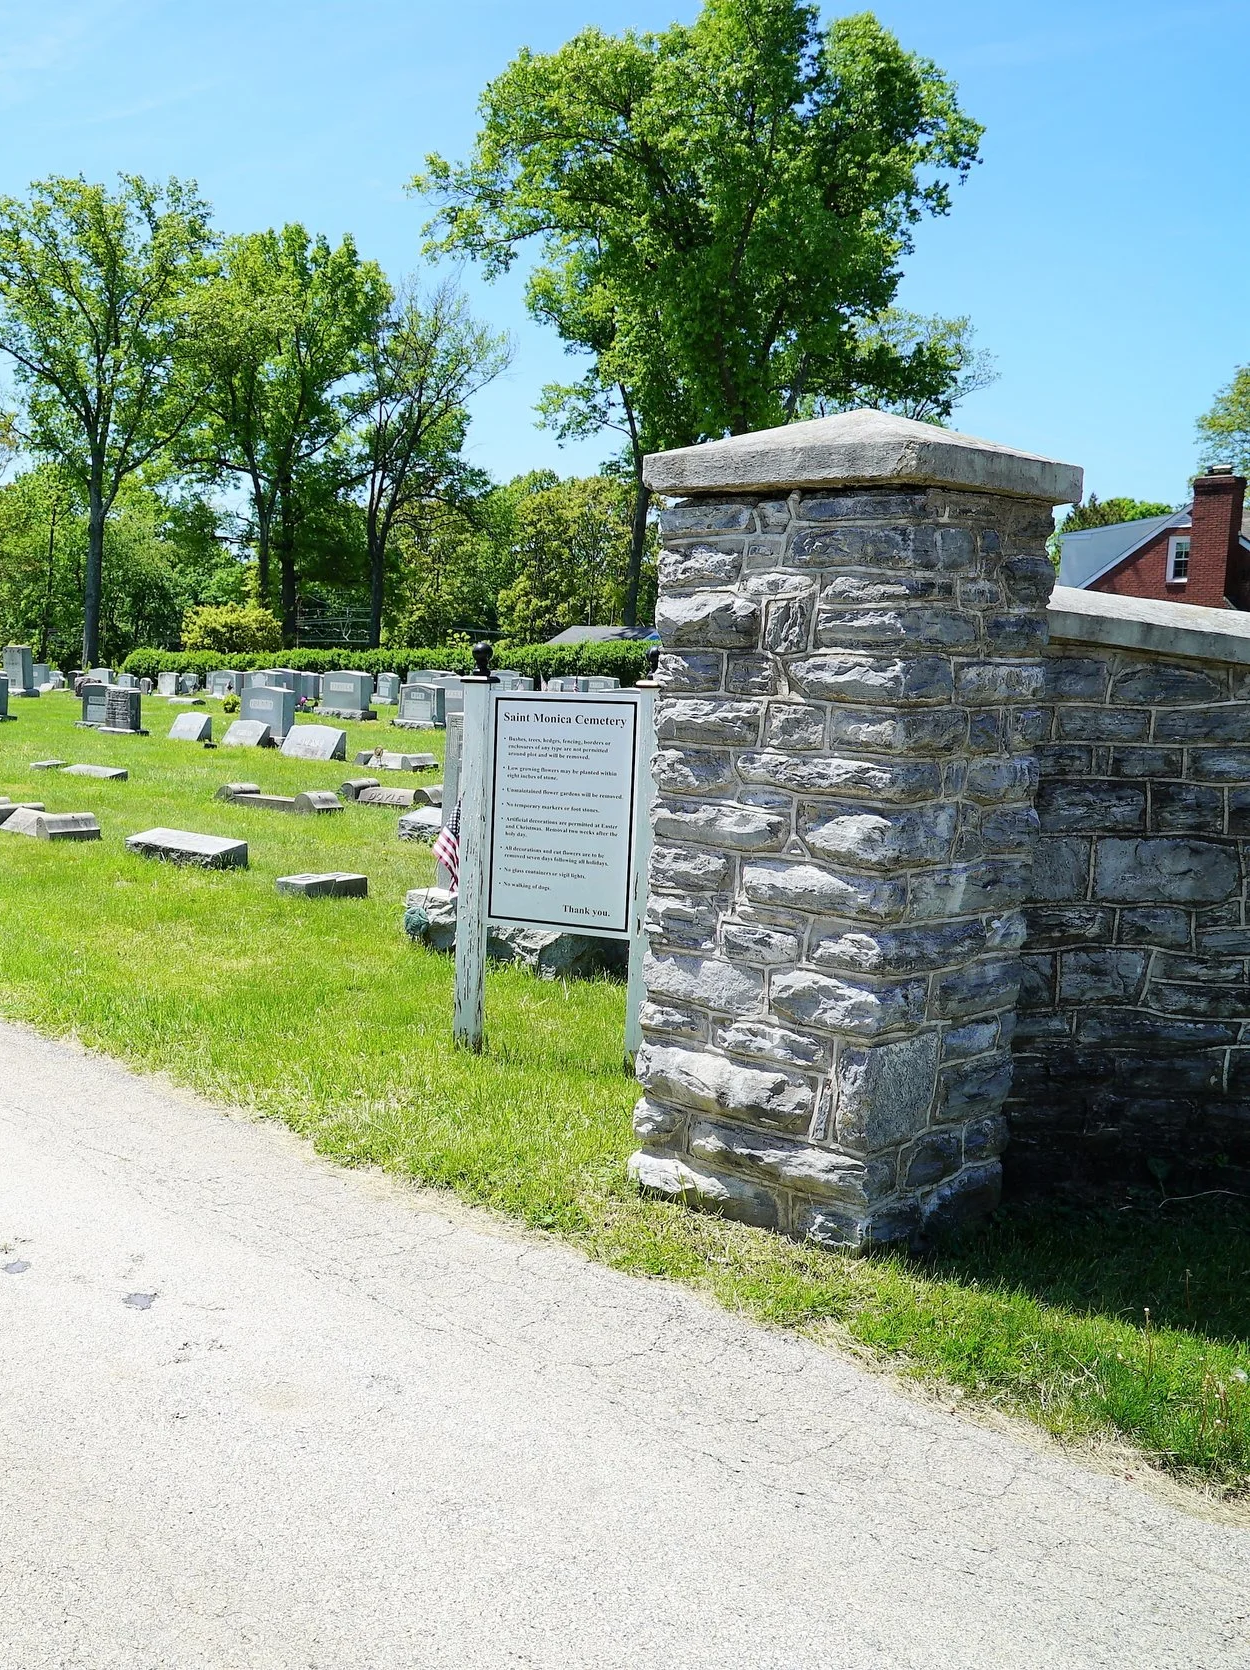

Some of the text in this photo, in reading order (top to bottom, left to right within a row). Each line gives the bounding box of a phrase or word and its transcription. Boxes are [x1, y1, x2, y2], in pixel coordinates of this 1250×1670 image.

[503, 712, 627, 729] Saint Monica Cemetery
[562, 738, 583, 746] fencing,
[579, 769, 600, 777] planted
[368, 792, 405, 804] DOYLE
[560, 790, 580, 798] gardens
[514, 802, 541, 810] temporary
[568, 821, 594, 829] permitted
[554, 856, 577, 864] following
[512, 882, 531, 890] walking
[538, 884, 551, 892] dogs.
[562, 905, 611, 919] Thank you.
